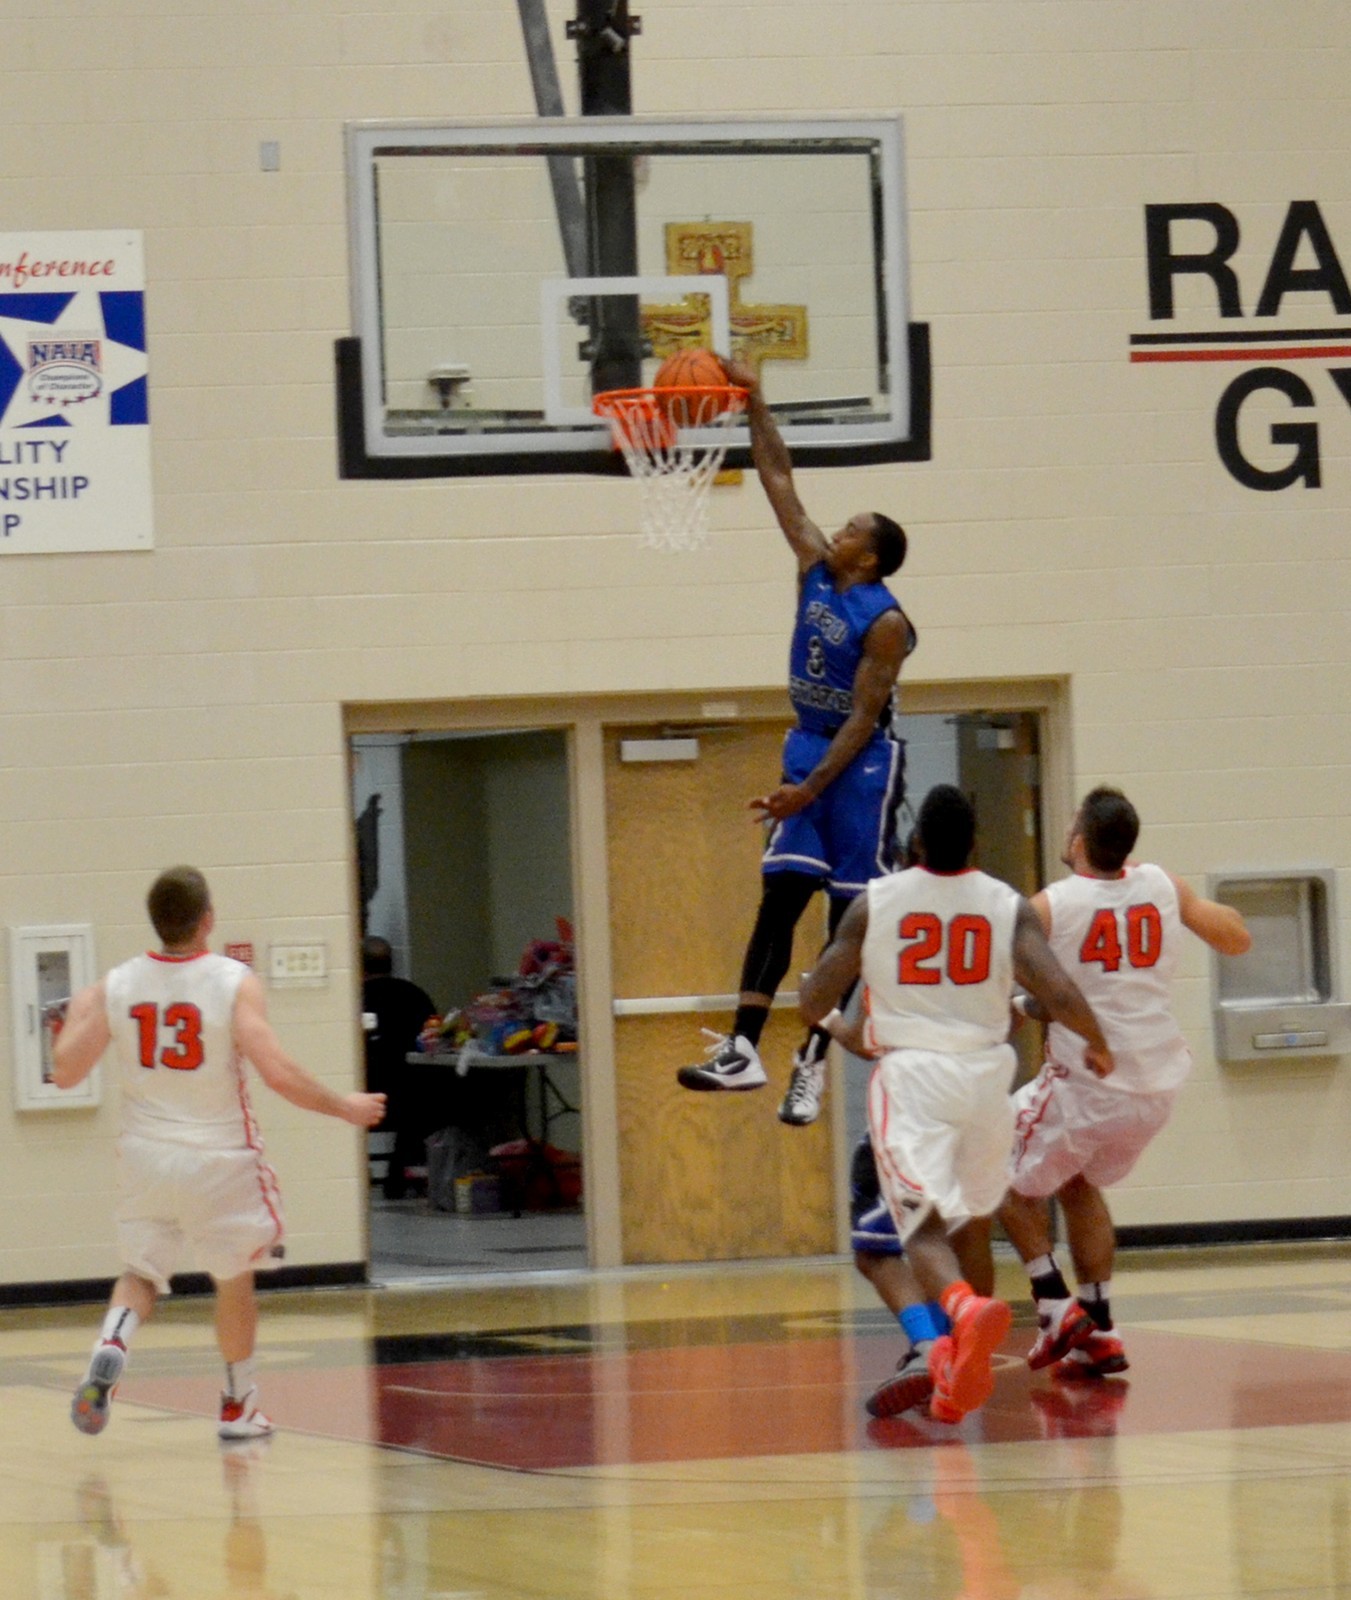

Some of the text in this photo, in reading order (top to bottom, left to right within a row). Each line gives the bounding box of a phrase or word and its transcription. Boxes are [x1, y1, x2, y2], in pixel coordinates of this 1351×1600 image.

[1144, 200, 1351, 320] RA
[31, 344, 97, 367] NAIA
[0, 440, 68, 465] LITY
[1215, 366, 1351, 492] G
[4, 514, 21, 537] P
[897, 911, 992, 985] 20
[1079, 902, 1162, 973] 40
[129, 1002, 204, 1071] 13
